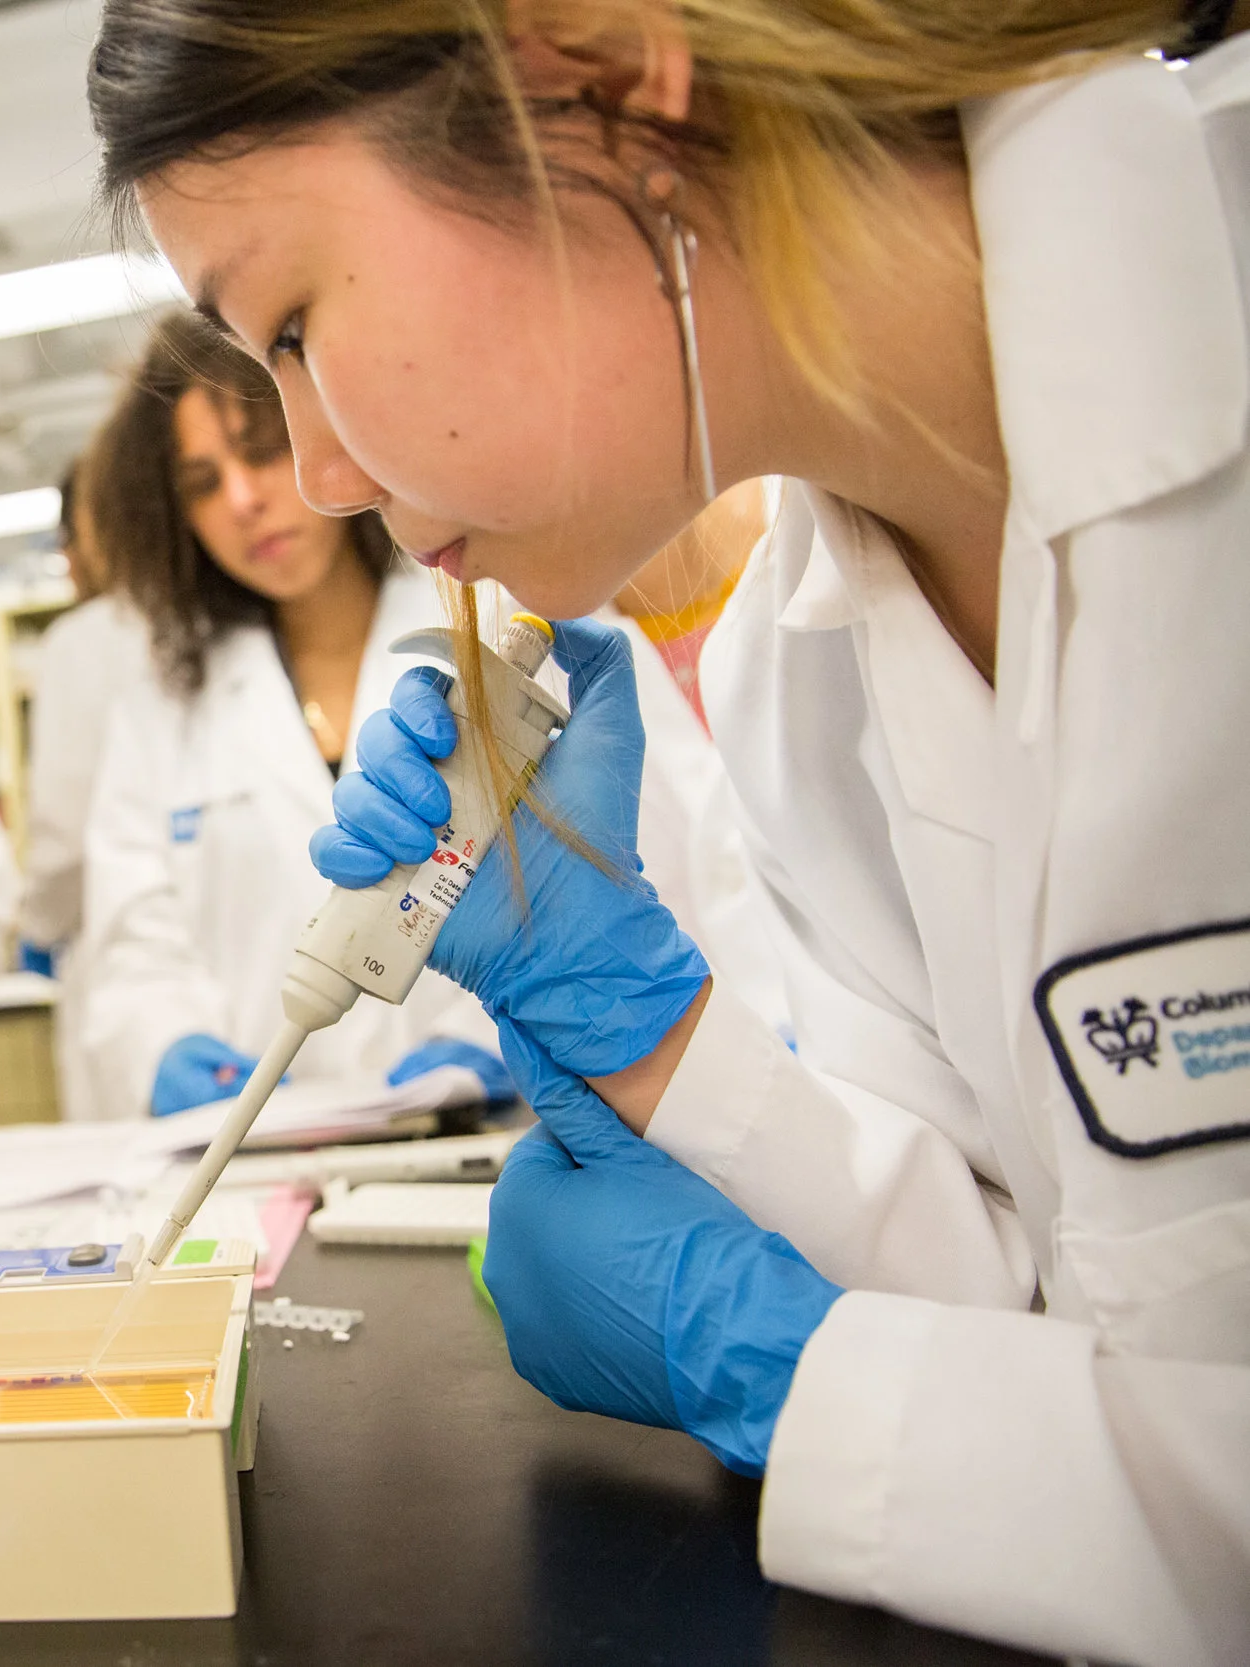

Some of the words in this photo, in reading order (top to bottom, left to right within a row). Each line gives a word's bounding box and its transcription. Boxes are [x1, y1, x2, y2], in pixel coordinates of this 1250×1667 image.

[438, 874, 449, 883] Cal
[434, 882, 444, 891] Cal
[363, 956, 385, 976] 100
